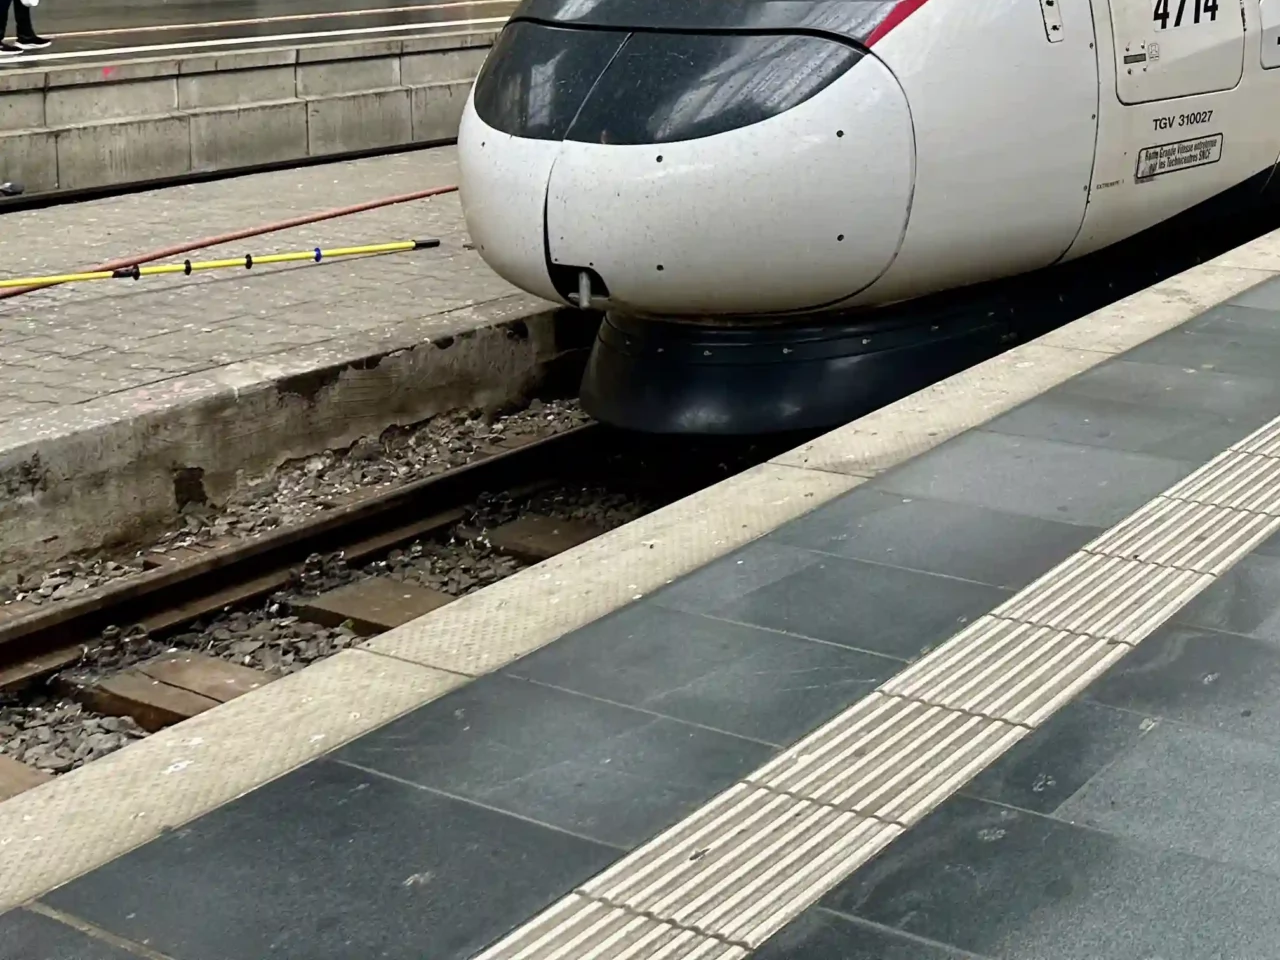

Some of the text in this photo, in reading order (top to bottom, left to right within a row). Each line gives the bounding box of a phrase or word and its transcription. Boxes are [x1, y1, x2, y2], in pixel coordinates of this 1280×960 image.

[1152, 110, 1214, 131] TGV 310027
[1159, 144, 1177, 159] Grande
[1177, 142, 1194, 154] Vitesse
[1198, 147, 1212, 162] SNCF
